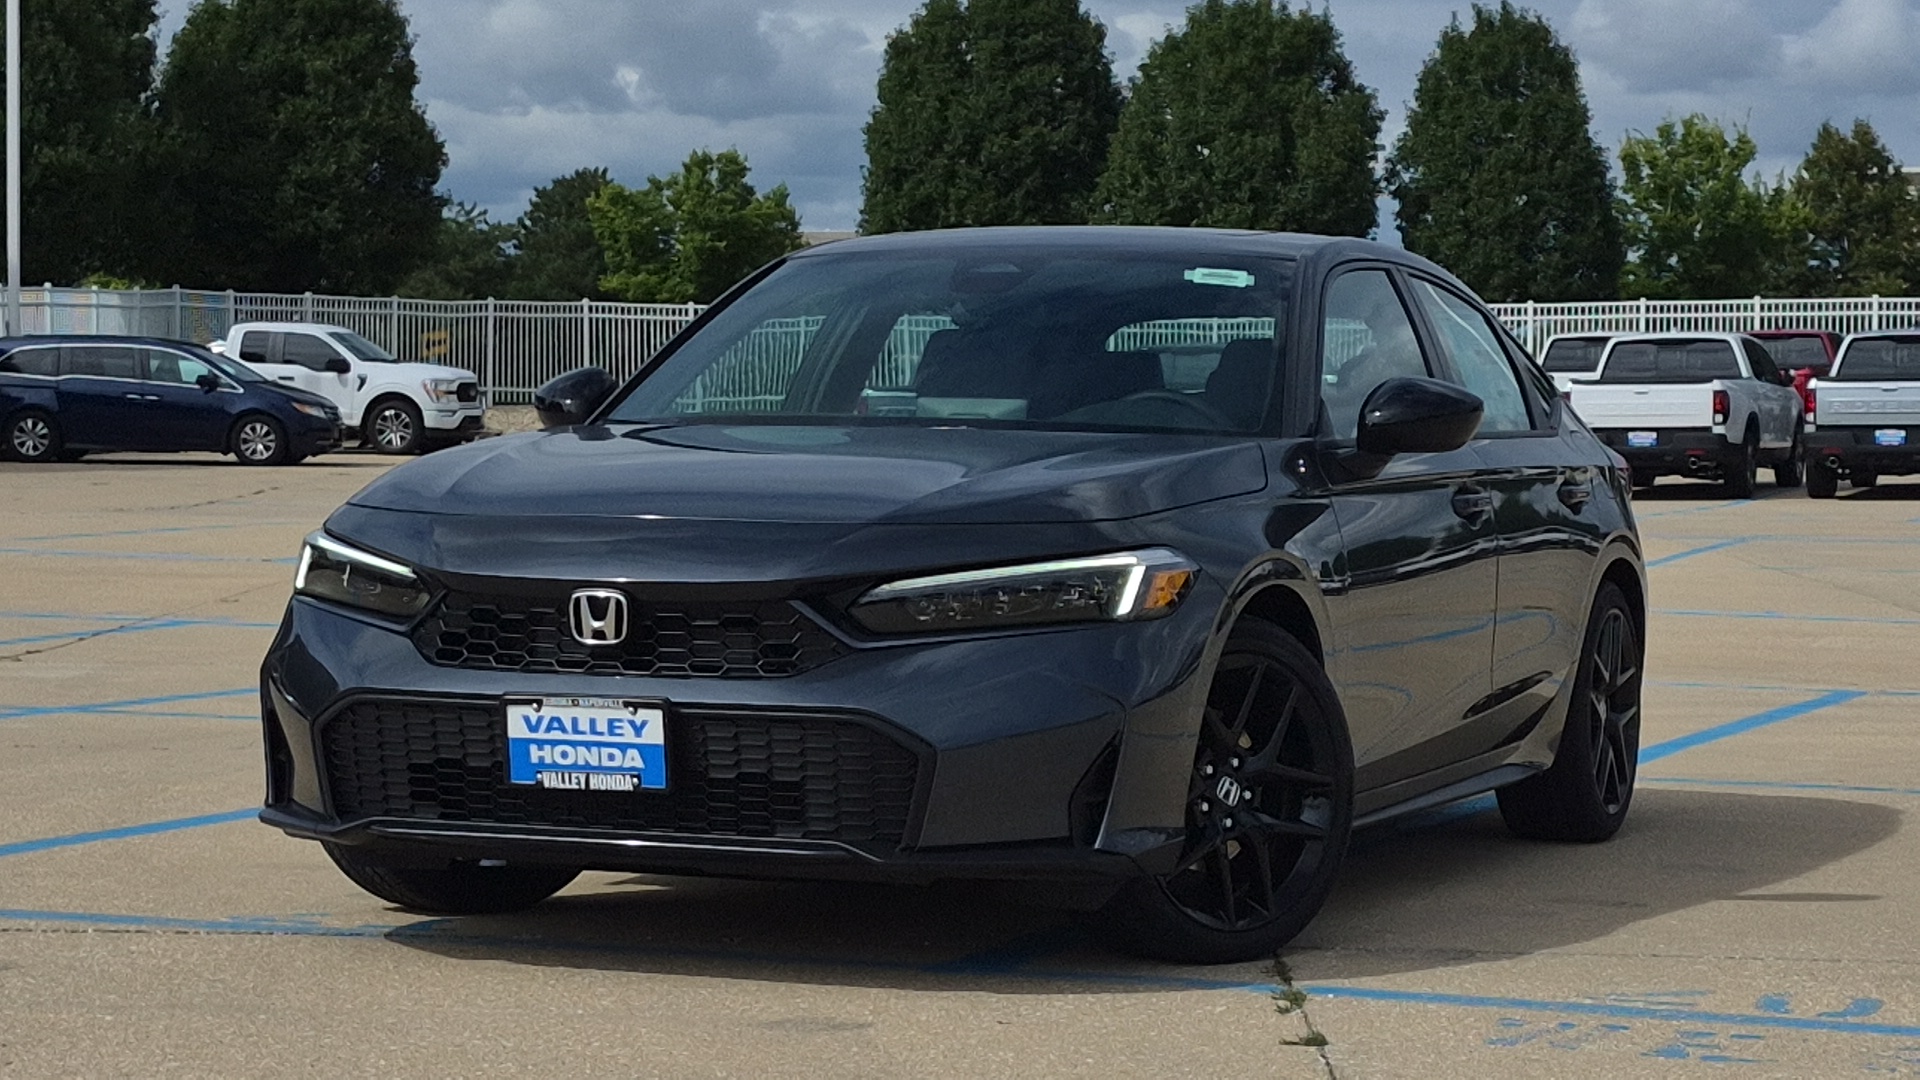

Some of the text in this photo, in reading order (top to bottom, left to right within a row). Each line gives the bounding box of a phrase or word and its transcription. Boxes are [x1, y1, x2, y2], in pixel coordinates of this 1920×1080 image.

[522, 714, 649, 738] VALLEY
[529, 743, 645, 769] HONDA
[542, 771, 634, 791] VALLEY HONDA
